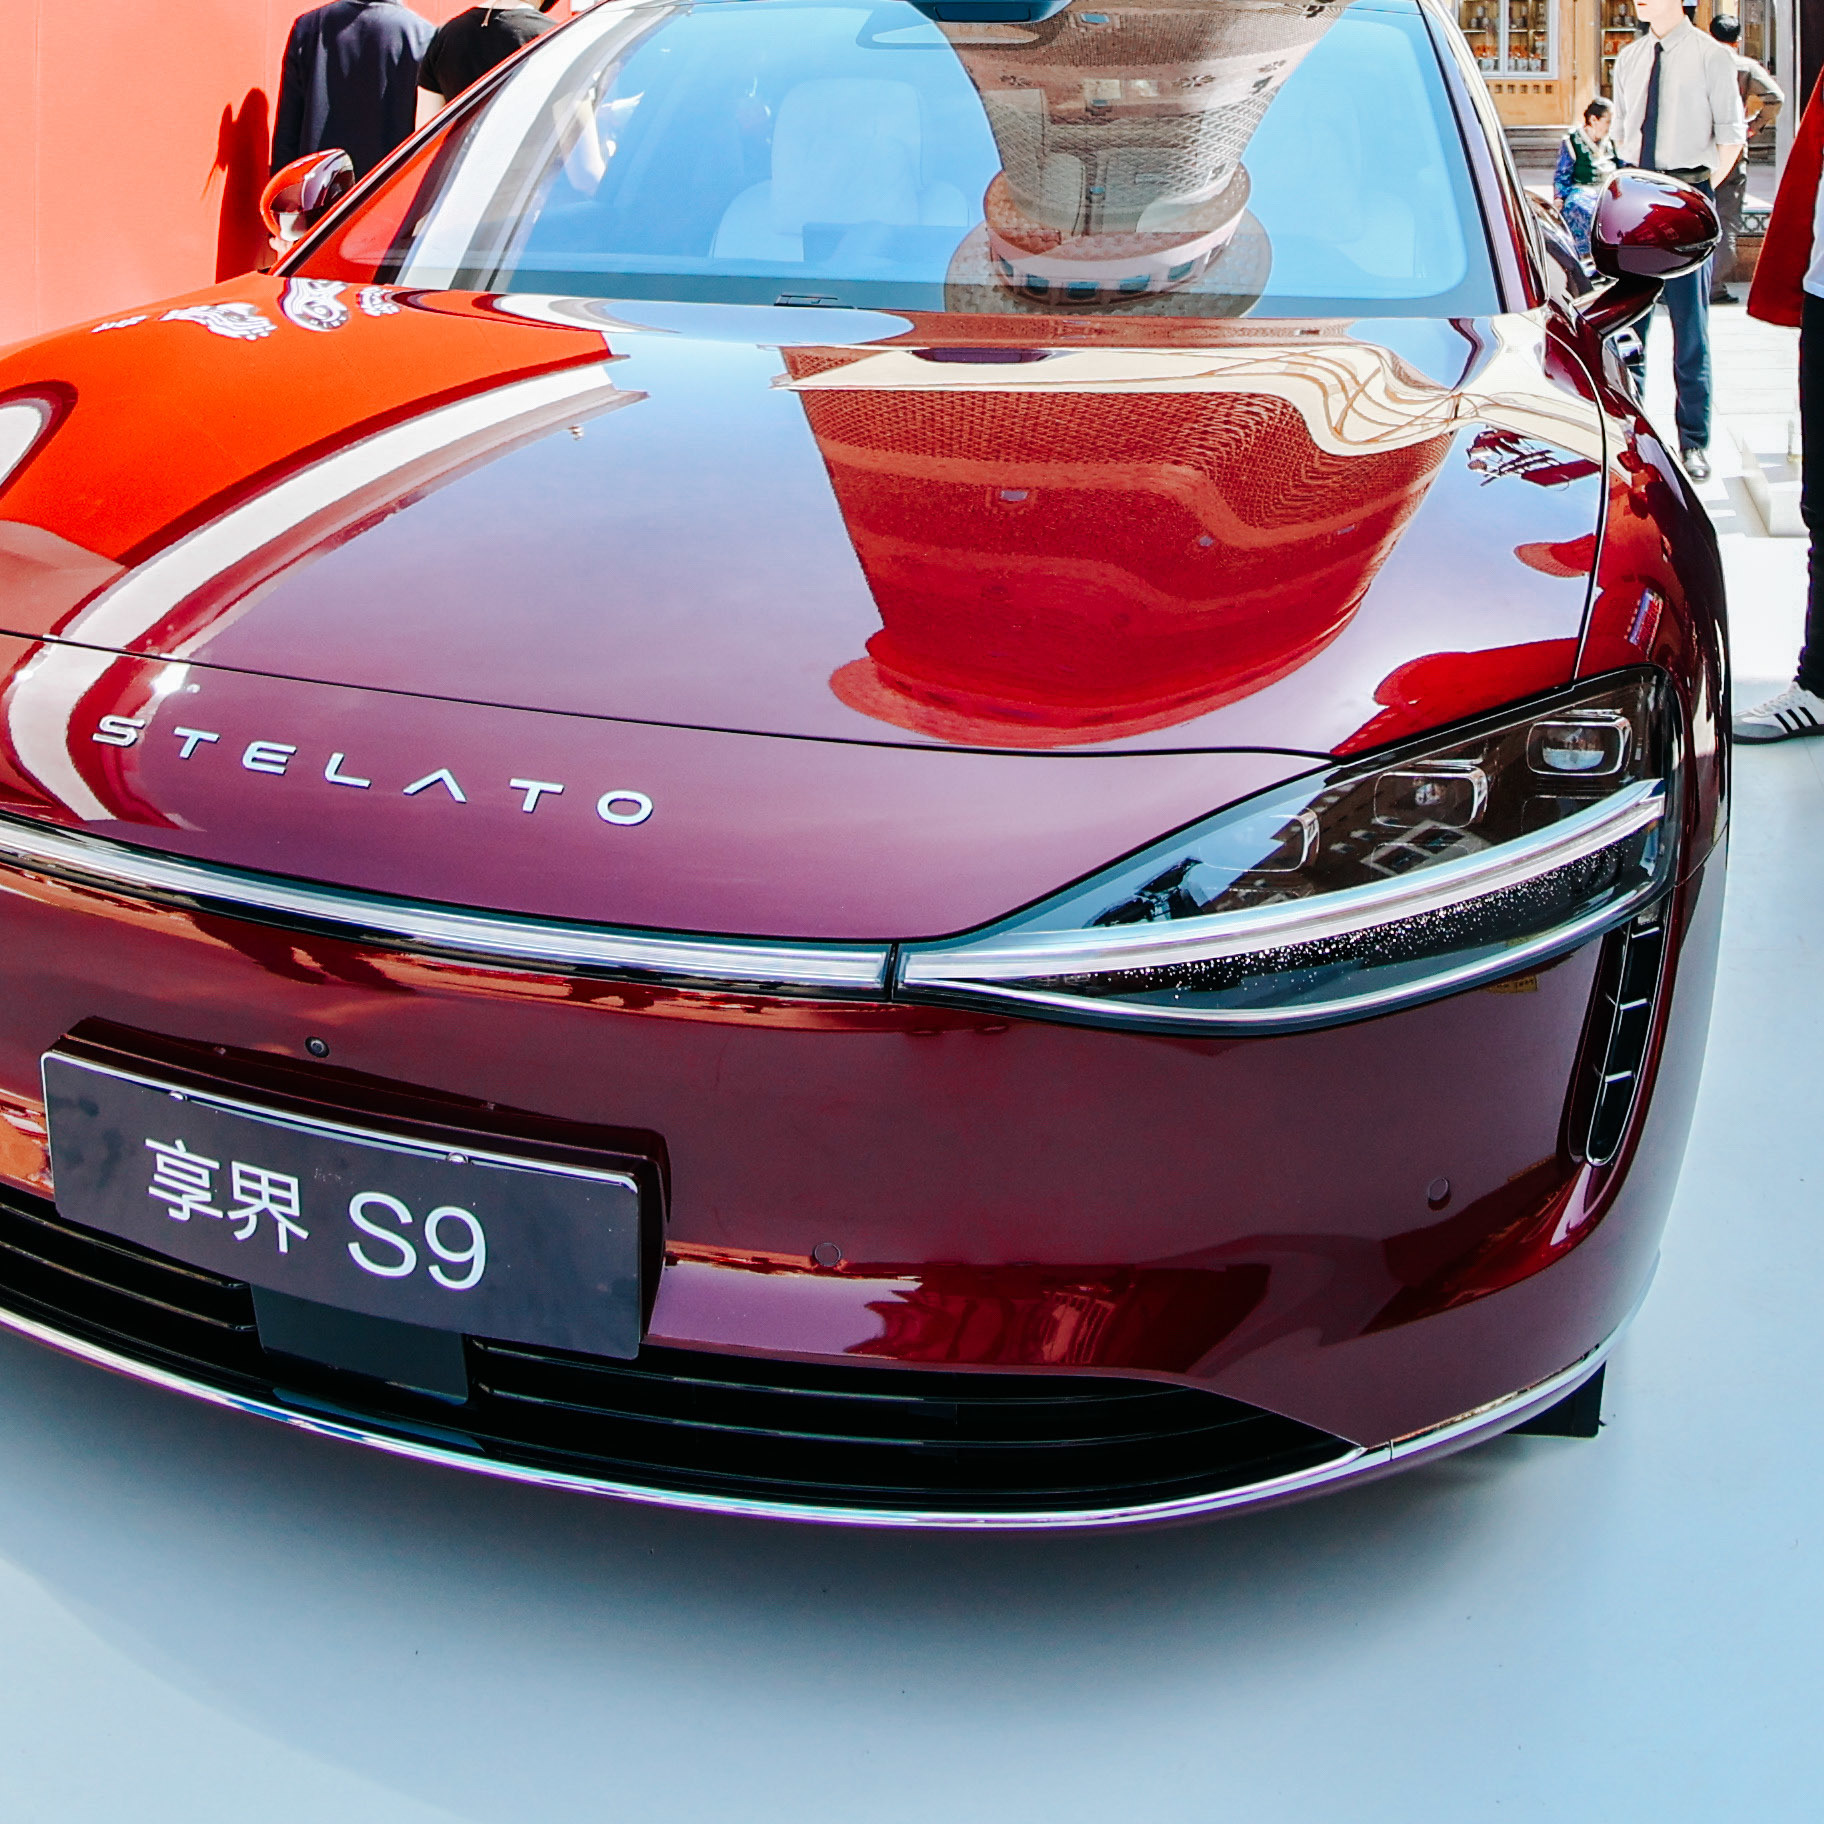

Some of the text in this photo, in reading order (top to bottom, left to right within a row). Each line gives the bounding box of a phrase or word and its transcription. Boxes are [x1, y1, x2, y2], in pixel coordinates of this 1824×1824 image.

[92, 713, 654, 827] STELATO
[144, 1138, 489, 1292] 享界 S9
